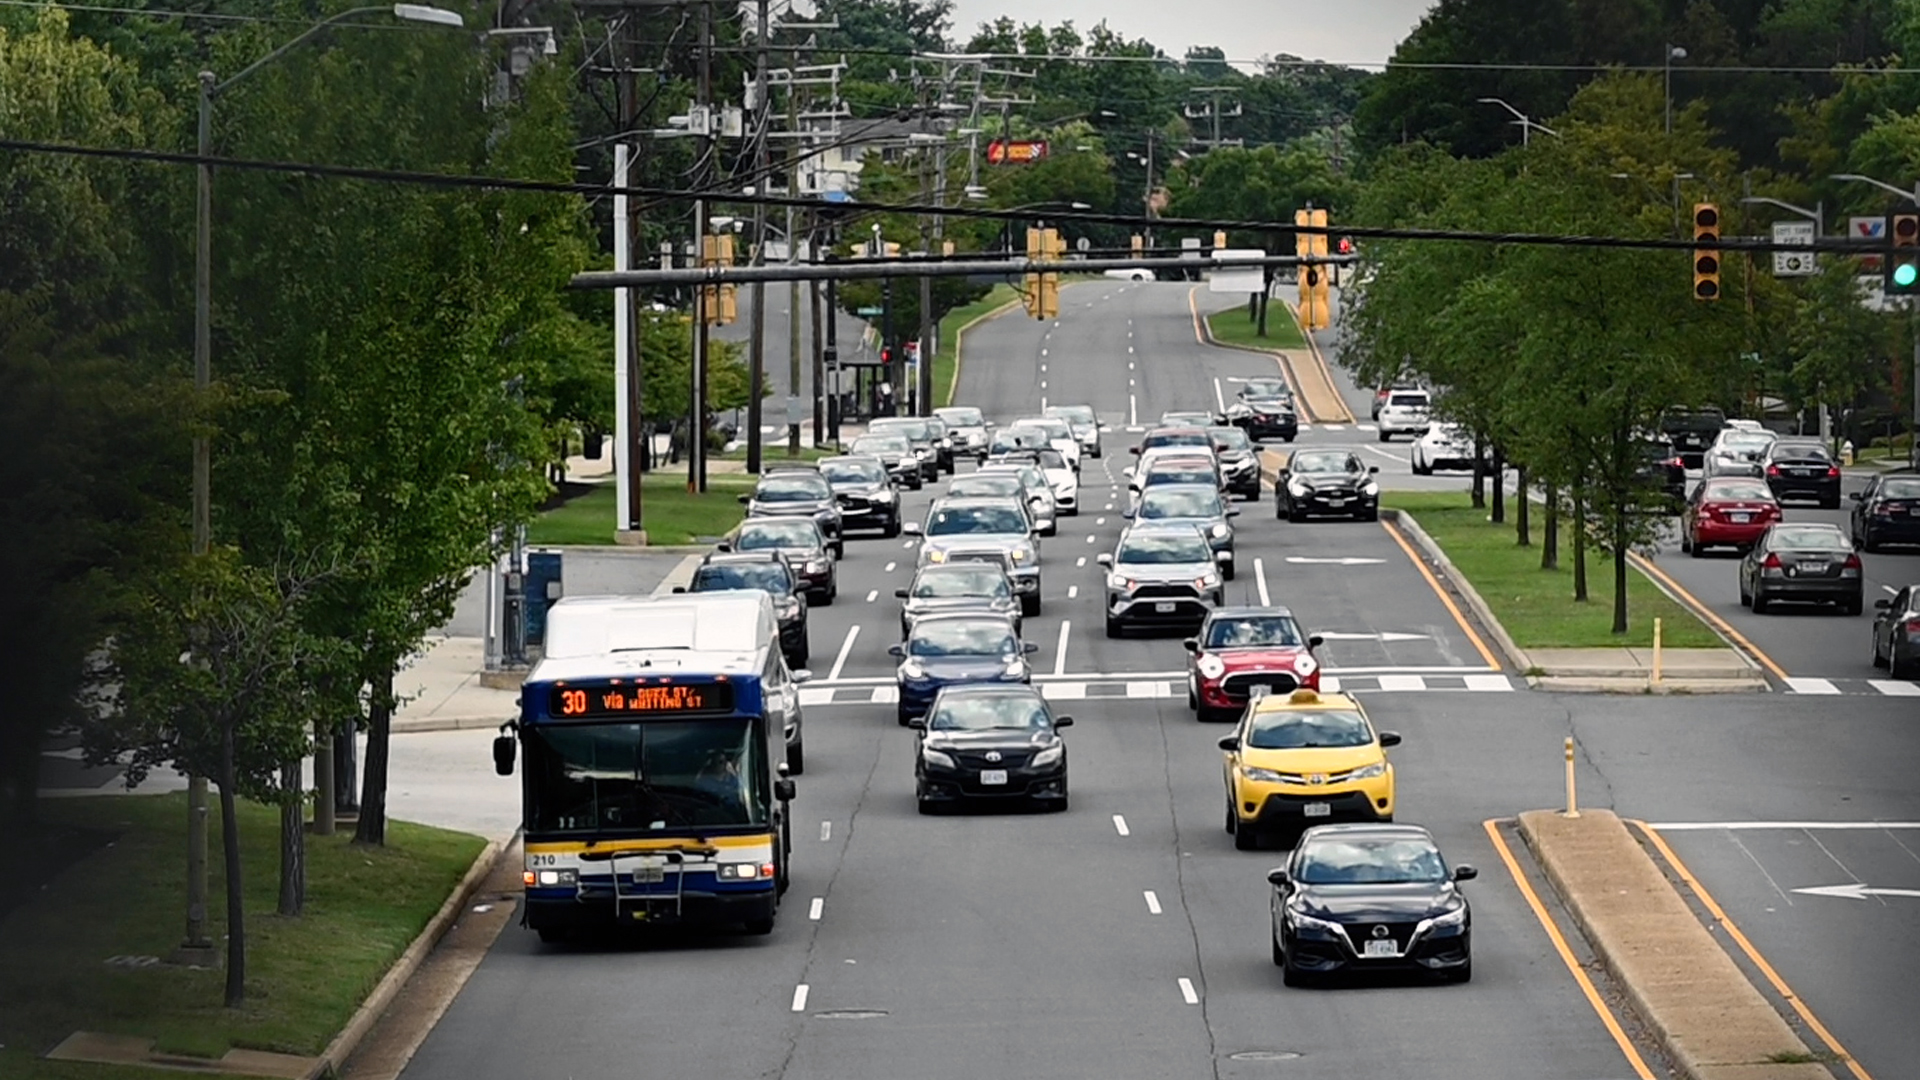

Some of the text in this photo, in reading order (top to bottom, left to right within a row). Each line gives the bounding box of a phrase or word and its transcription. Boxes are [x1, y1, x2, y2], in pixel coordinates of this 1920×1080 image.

[562, 690, 624, 713] 30 via
[533, 855, 556, 866] 210
